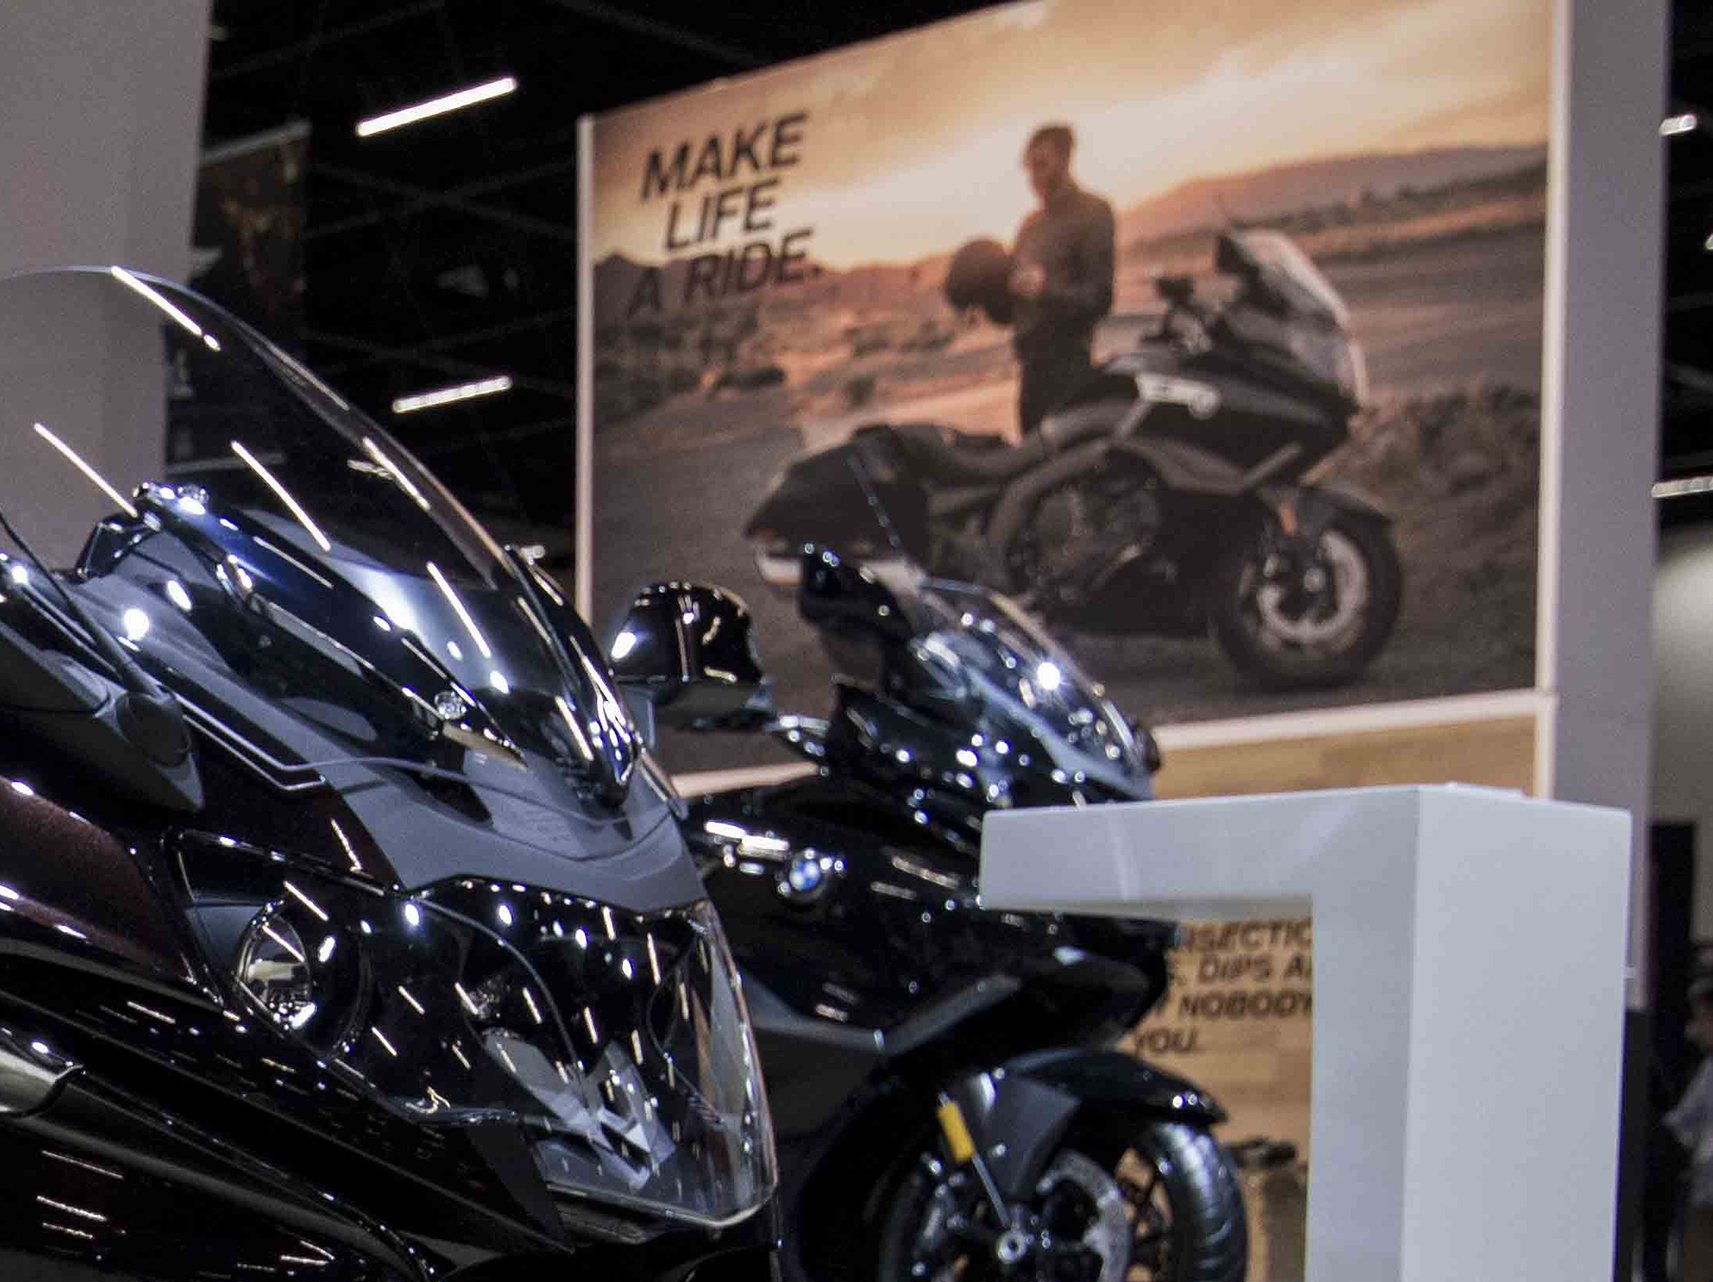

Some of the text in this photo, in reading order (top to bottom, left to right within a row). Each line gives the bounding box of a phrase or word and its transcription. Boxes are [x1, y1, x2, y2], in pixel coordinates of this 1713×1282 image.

[641, 110, 809, 201] MAKE
[664, 177, 779, 250] LIFE
[626, 228, 822, 317] A RIDE.
